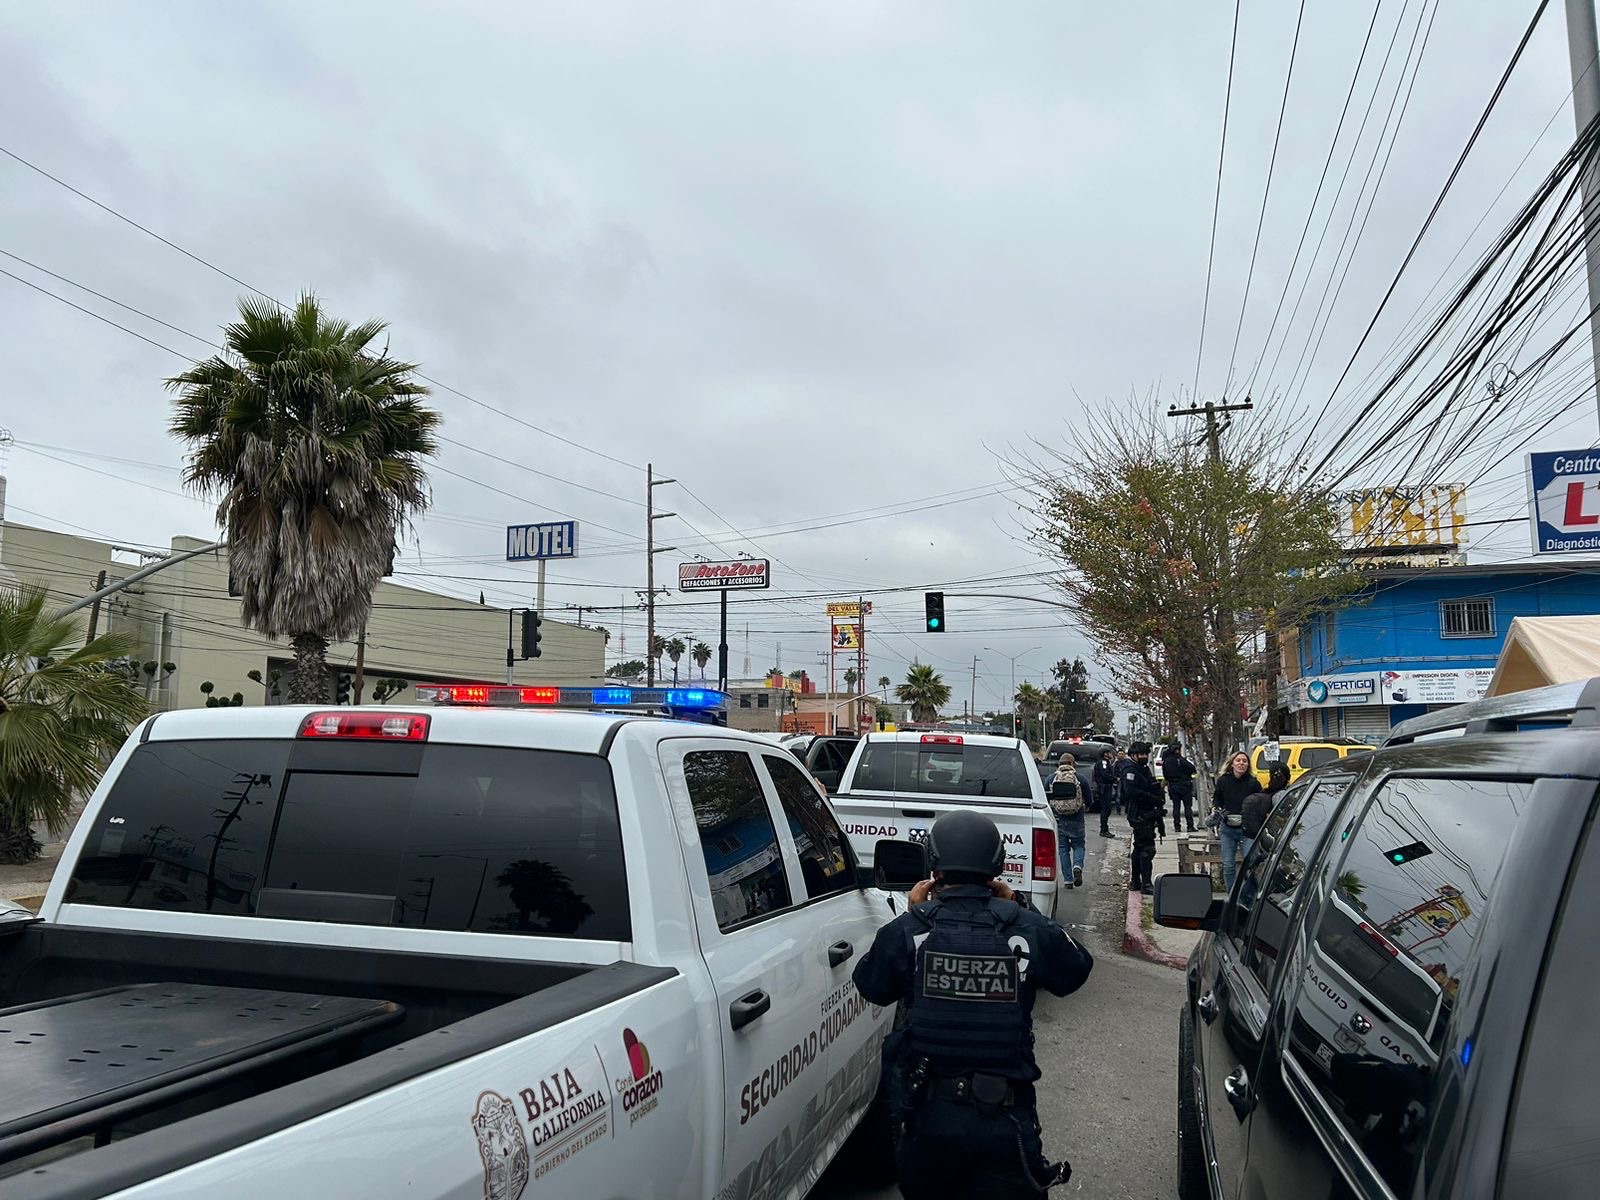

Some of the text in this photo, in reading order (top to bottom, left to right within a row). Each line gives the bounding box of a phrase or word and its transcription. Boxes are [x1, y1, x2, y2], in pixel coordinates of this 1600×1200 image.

[1563, 481, 1600, 526] L
[508, 524, 572, 558] MOTEL
[1546, 535, 1600, 551] Diagnósti
[682, 579, 721, 587] REFACCIONES
[728, 576, 763, 585] ACCESORIOS
[695, 562, 765, 578] AutoZone
[842, 824, 1024, 845] URIDAD NA
[932, 957, 1009, 975] FUERZA
[927, 973, 1014, 993] ESTATAL
[821, 990, 842, 1016] FUERZA
[623, 1066, 663, 1112] corazón
[740, 1030, 817, 1125] SEGURIDAD
[519, 1067, 582, 1122] BAJA
[532, 1090, 606, 1146] CALIFORNIA
[534, 1123, 608, 1179] GOBIERNO DEL ESTADO
